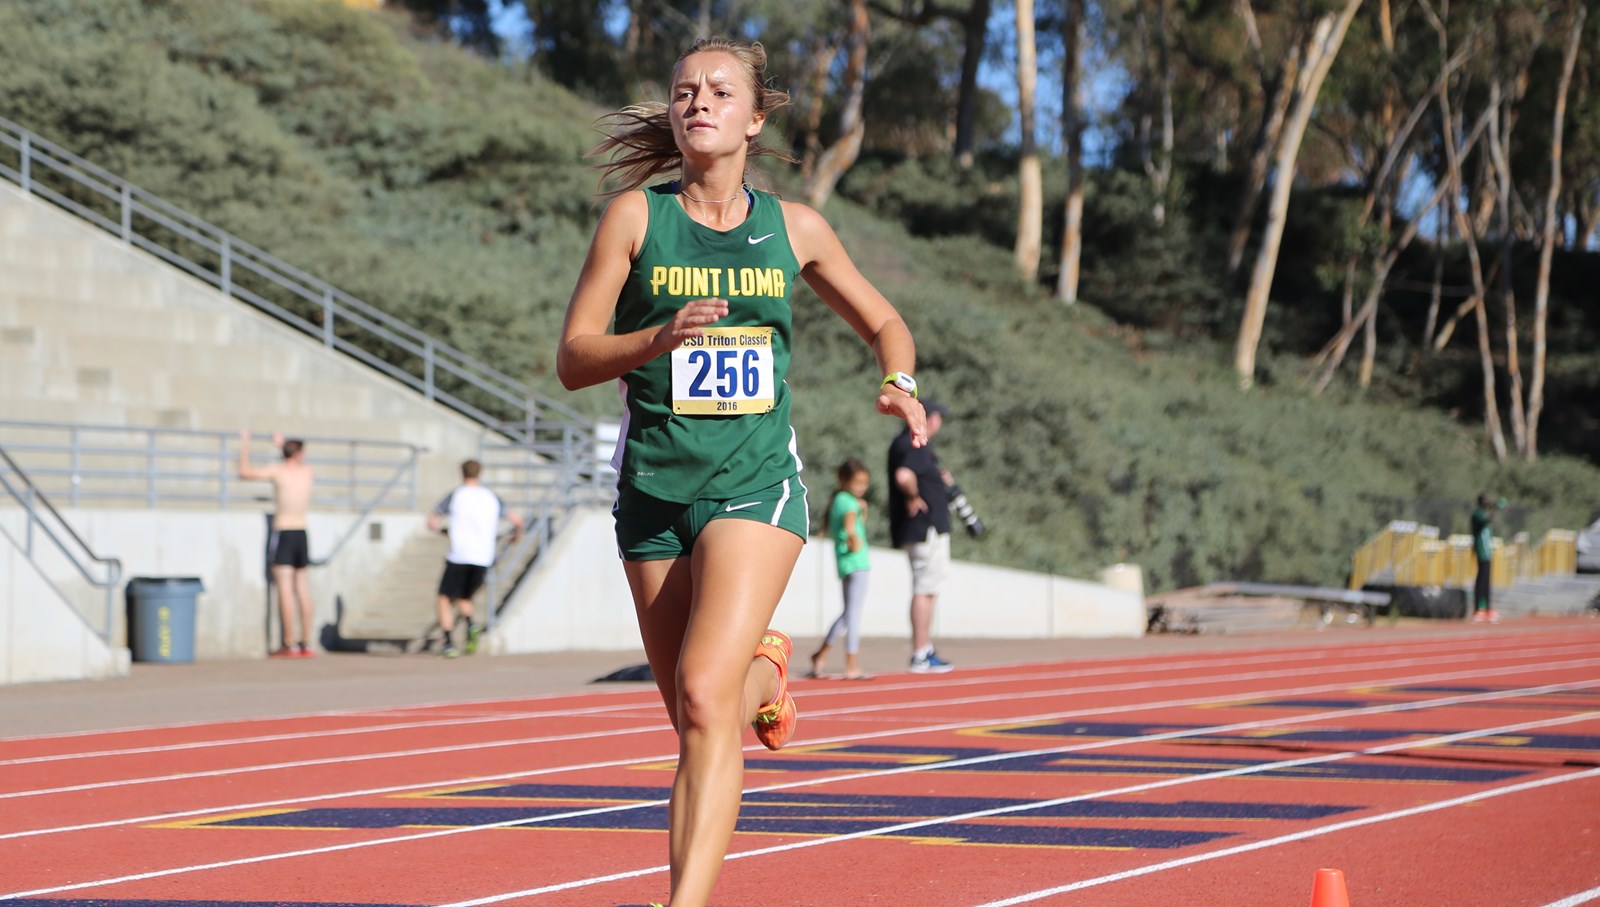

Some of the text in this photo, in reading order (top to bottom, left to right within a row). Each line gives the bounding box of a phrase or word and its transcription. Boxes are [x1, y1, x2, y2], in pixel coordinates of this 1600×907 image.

[650, 266, 786, 298] POINT LOMA
[683, 333, 768, 347] CSD Triton Classic
[688, 349, 760, 398] 256
[716, 401, 738, 411] 2016
